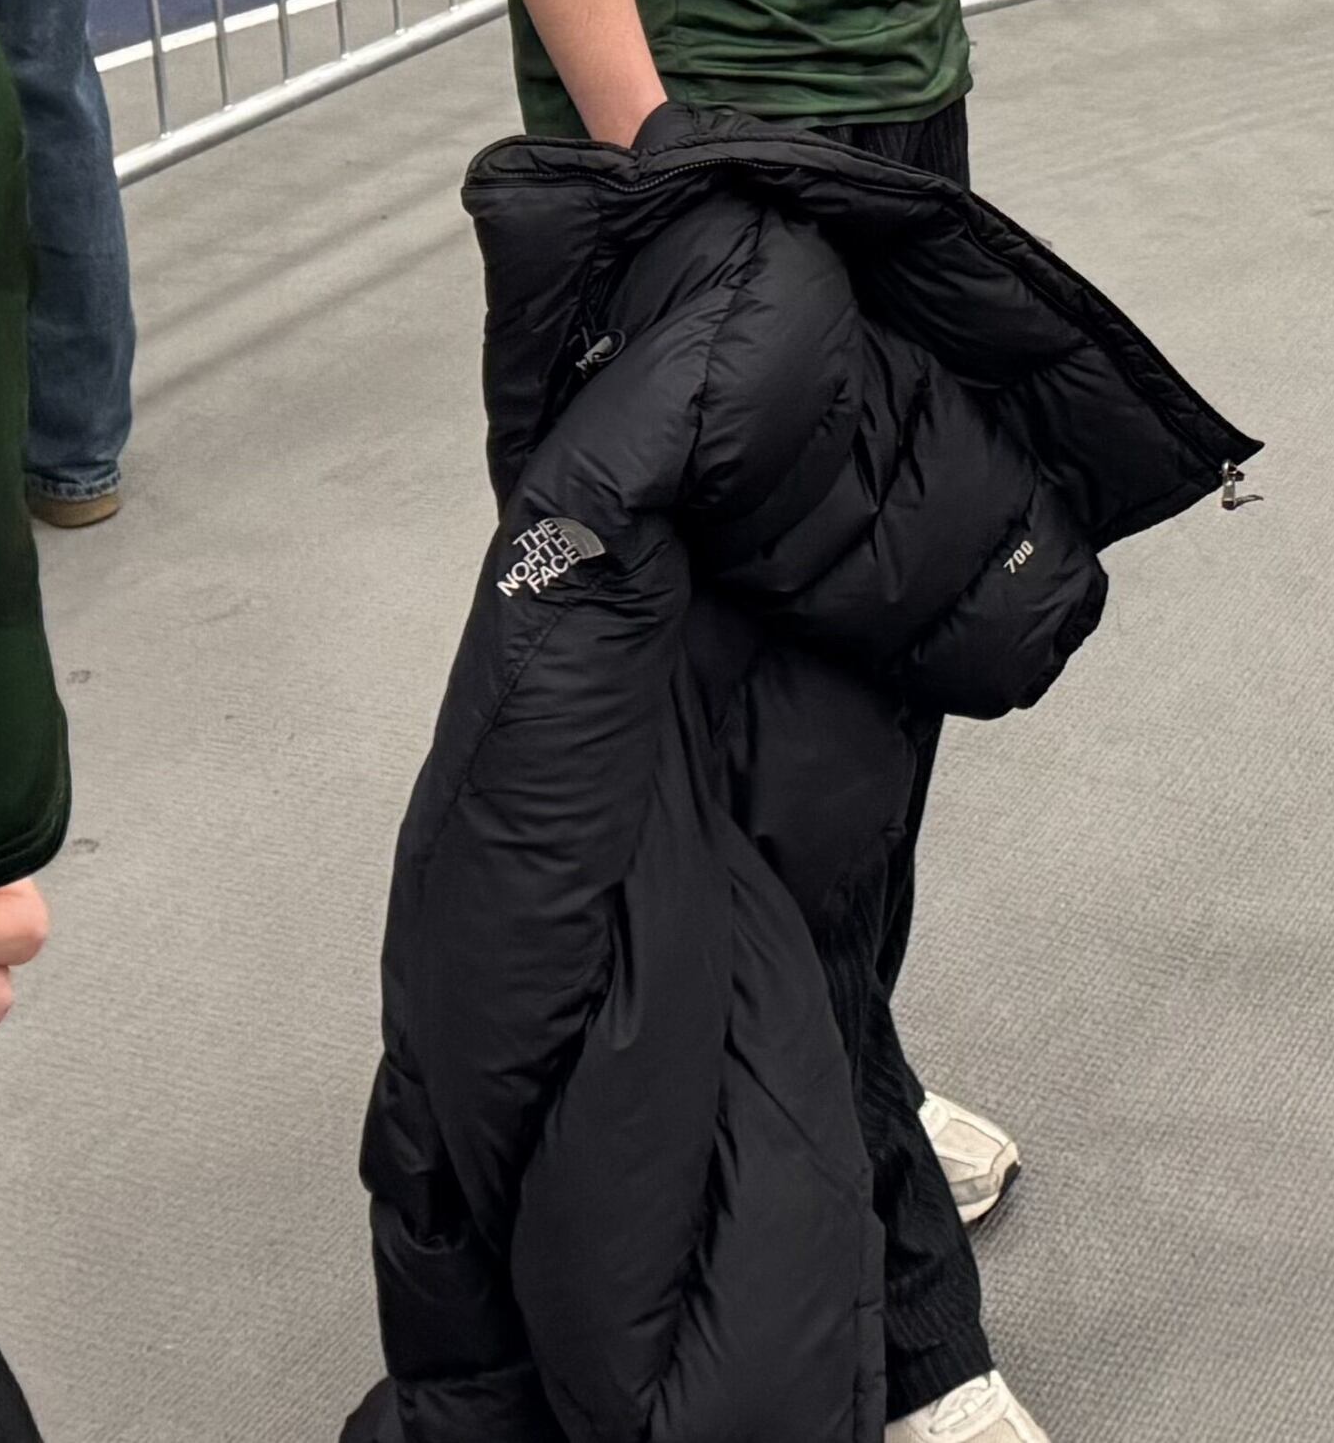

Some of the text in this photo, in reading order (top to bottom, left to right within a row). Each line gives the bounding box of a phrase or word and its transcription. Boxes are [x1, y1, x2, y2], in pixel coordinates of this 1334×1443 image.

[512, 517, 559, 553] THE
[496, 530, 571, 597] NORTH
[526, 545, 582, 594] FACE
[1002, 540, 1034, 574] 700
